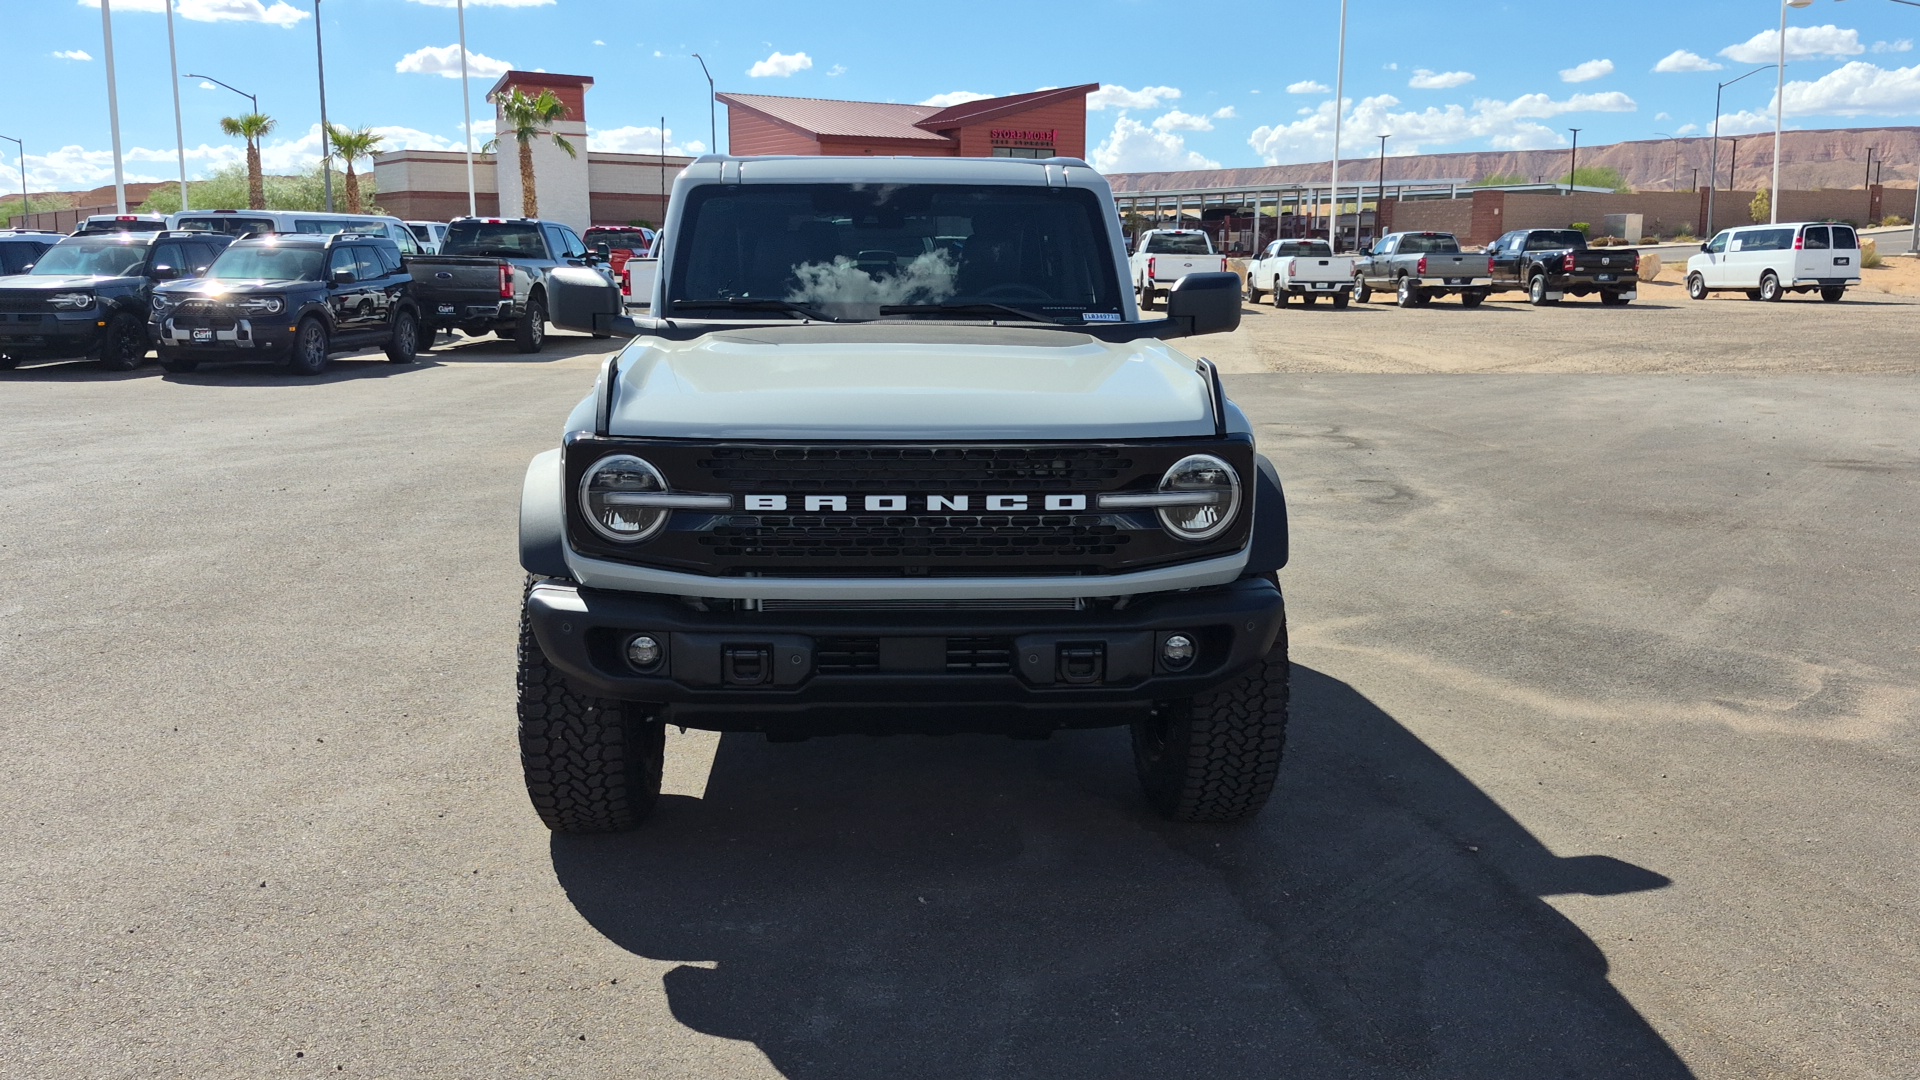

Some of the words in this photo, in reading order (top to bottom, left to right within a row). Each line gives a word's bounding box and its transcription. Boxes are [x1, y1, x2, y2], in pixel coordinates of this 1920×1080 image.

[991, 129, 1023, 139] STORE
[193, 330, 212, 339] Garff
[745, 494, 1086, 511] BRONCO
